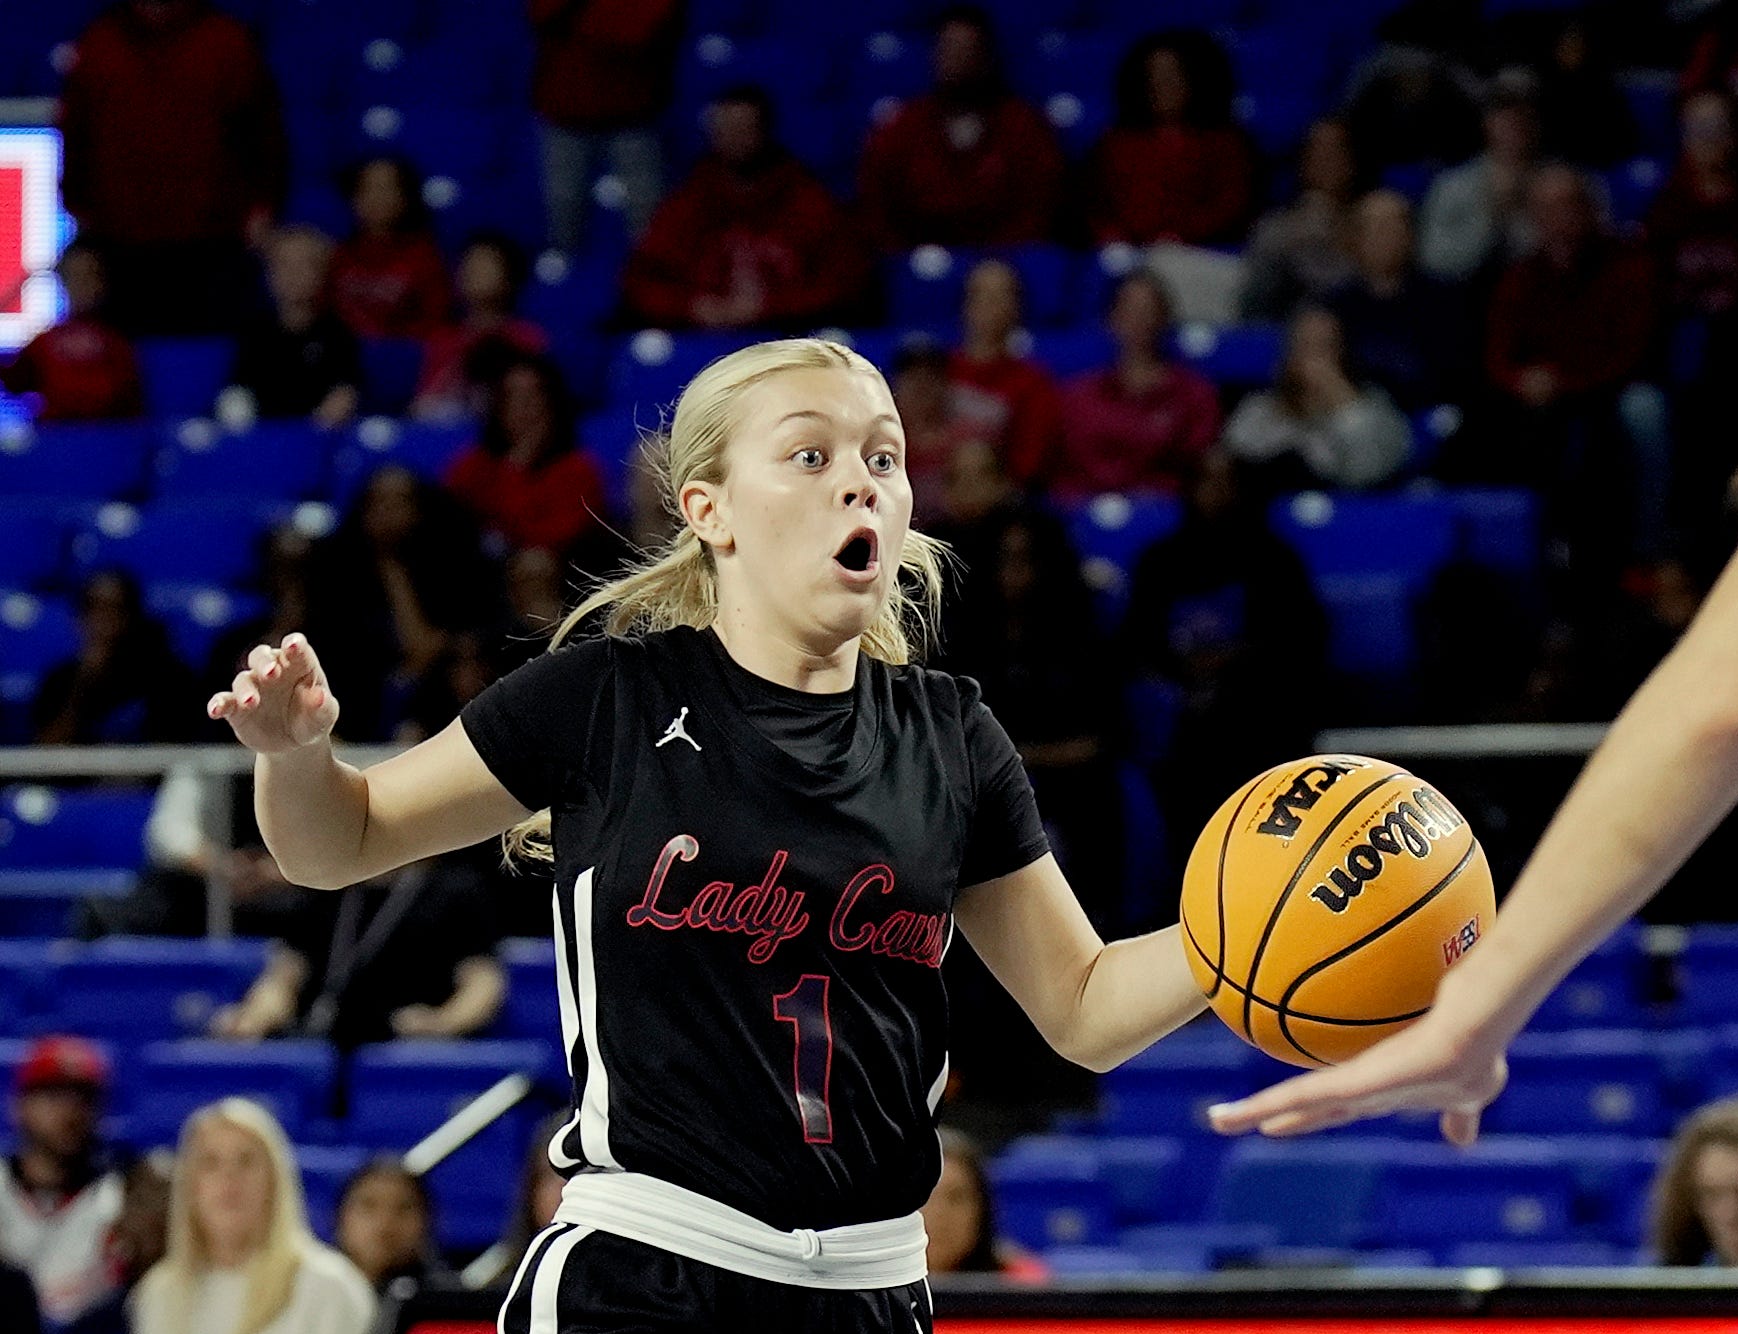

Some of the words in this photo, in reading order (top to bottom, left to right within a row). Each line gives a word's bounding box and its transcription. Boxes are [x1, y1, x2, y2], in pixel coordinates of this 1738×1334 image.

[626, 834, 810, 964] Lady
[1307, 785, 1466, 915] Wilson
[773, 973, 833, 1144] 1
